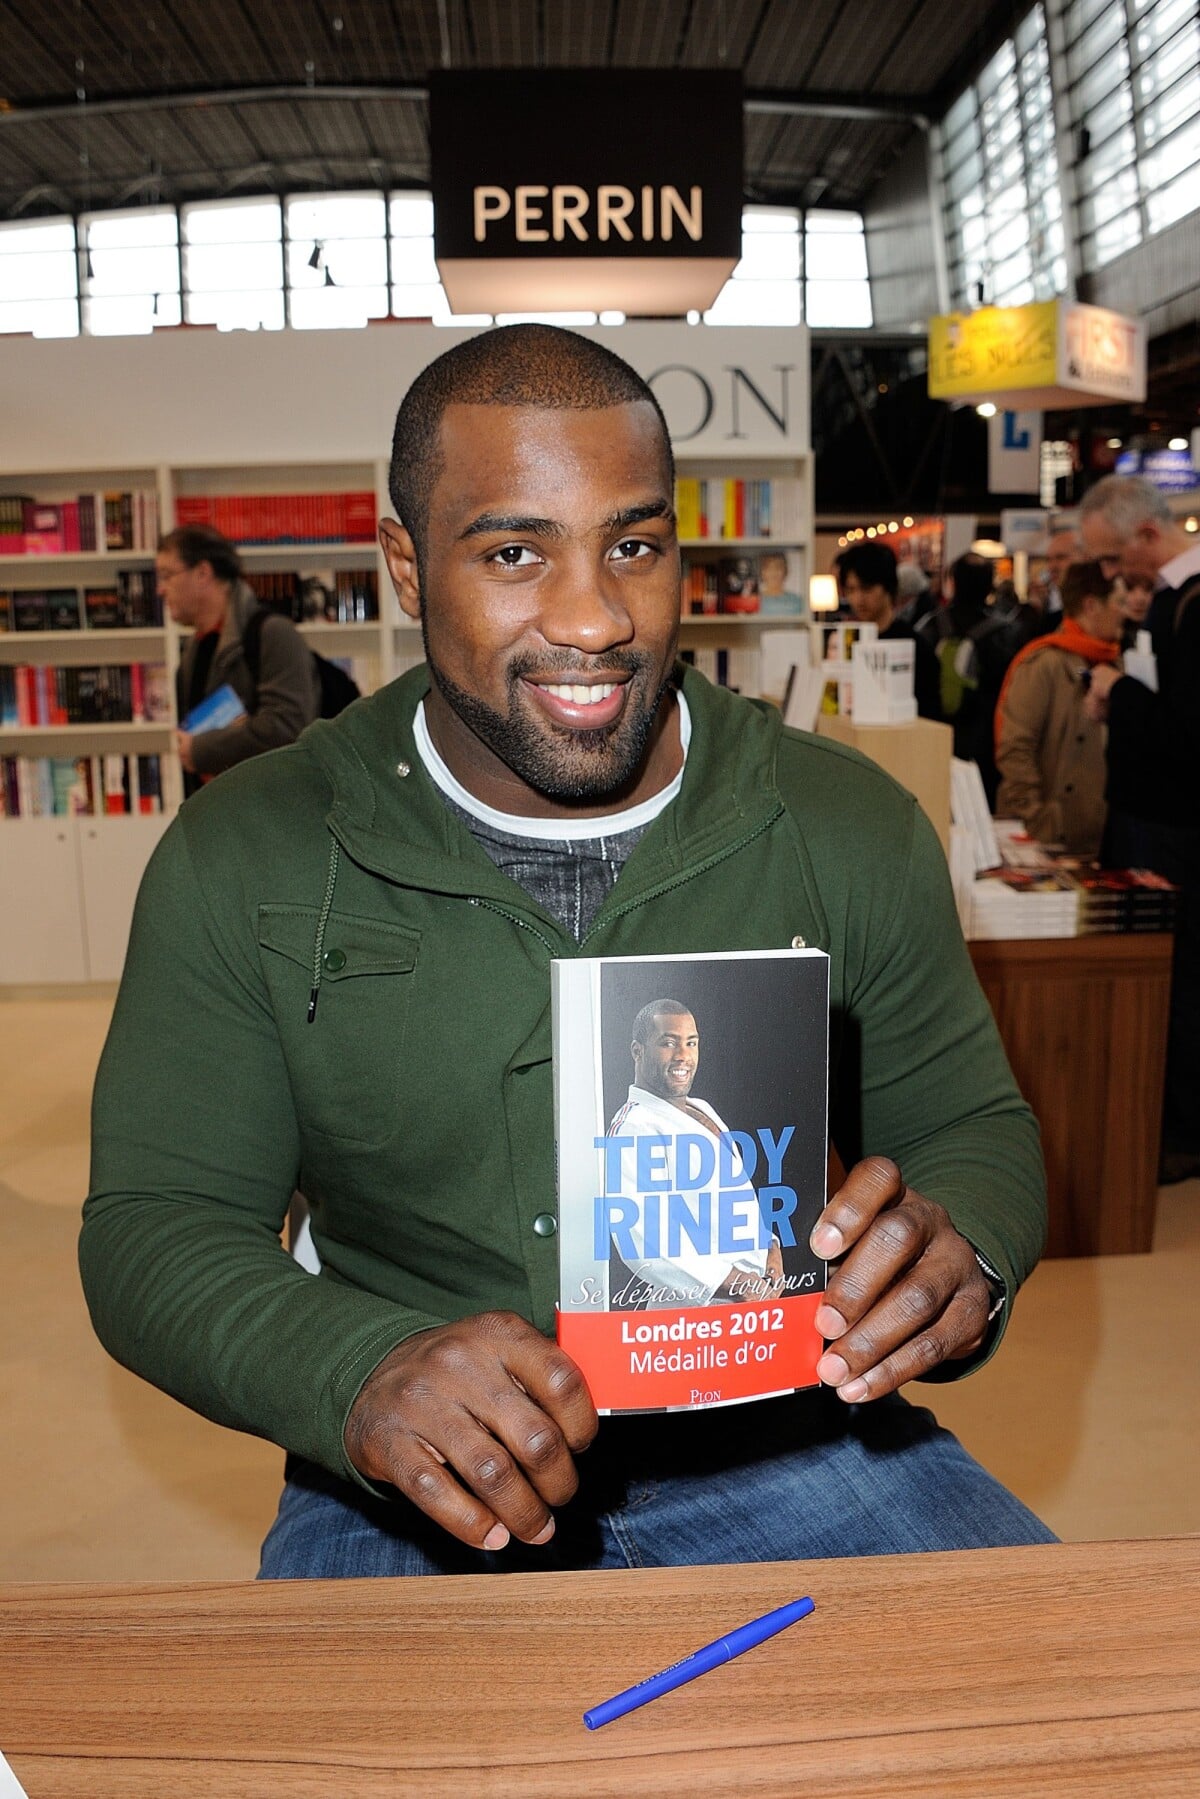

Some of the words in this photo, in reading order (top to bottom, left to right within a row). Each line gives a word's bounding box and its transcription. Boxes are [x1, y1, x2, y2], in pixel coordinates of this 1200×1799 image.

[474, 185, 703, 242] PERRIN
[647, 364, 797, 441] ON
[594, 1126, 797, 1194] TEDDY
[594, 1184, 798, 1261] RINER
[570, 1277, 603, 1306] Se
[729, 1271, 817, 1301] toujours
[622, 1317, 723, 1344] Londres
[729, 1308, 784, 1336] 2012
[630, 1344, 728, 1374] Médaille
[735, 1341, 777, 1365] d'or
[690, 1389, 721, 1404] PLON
